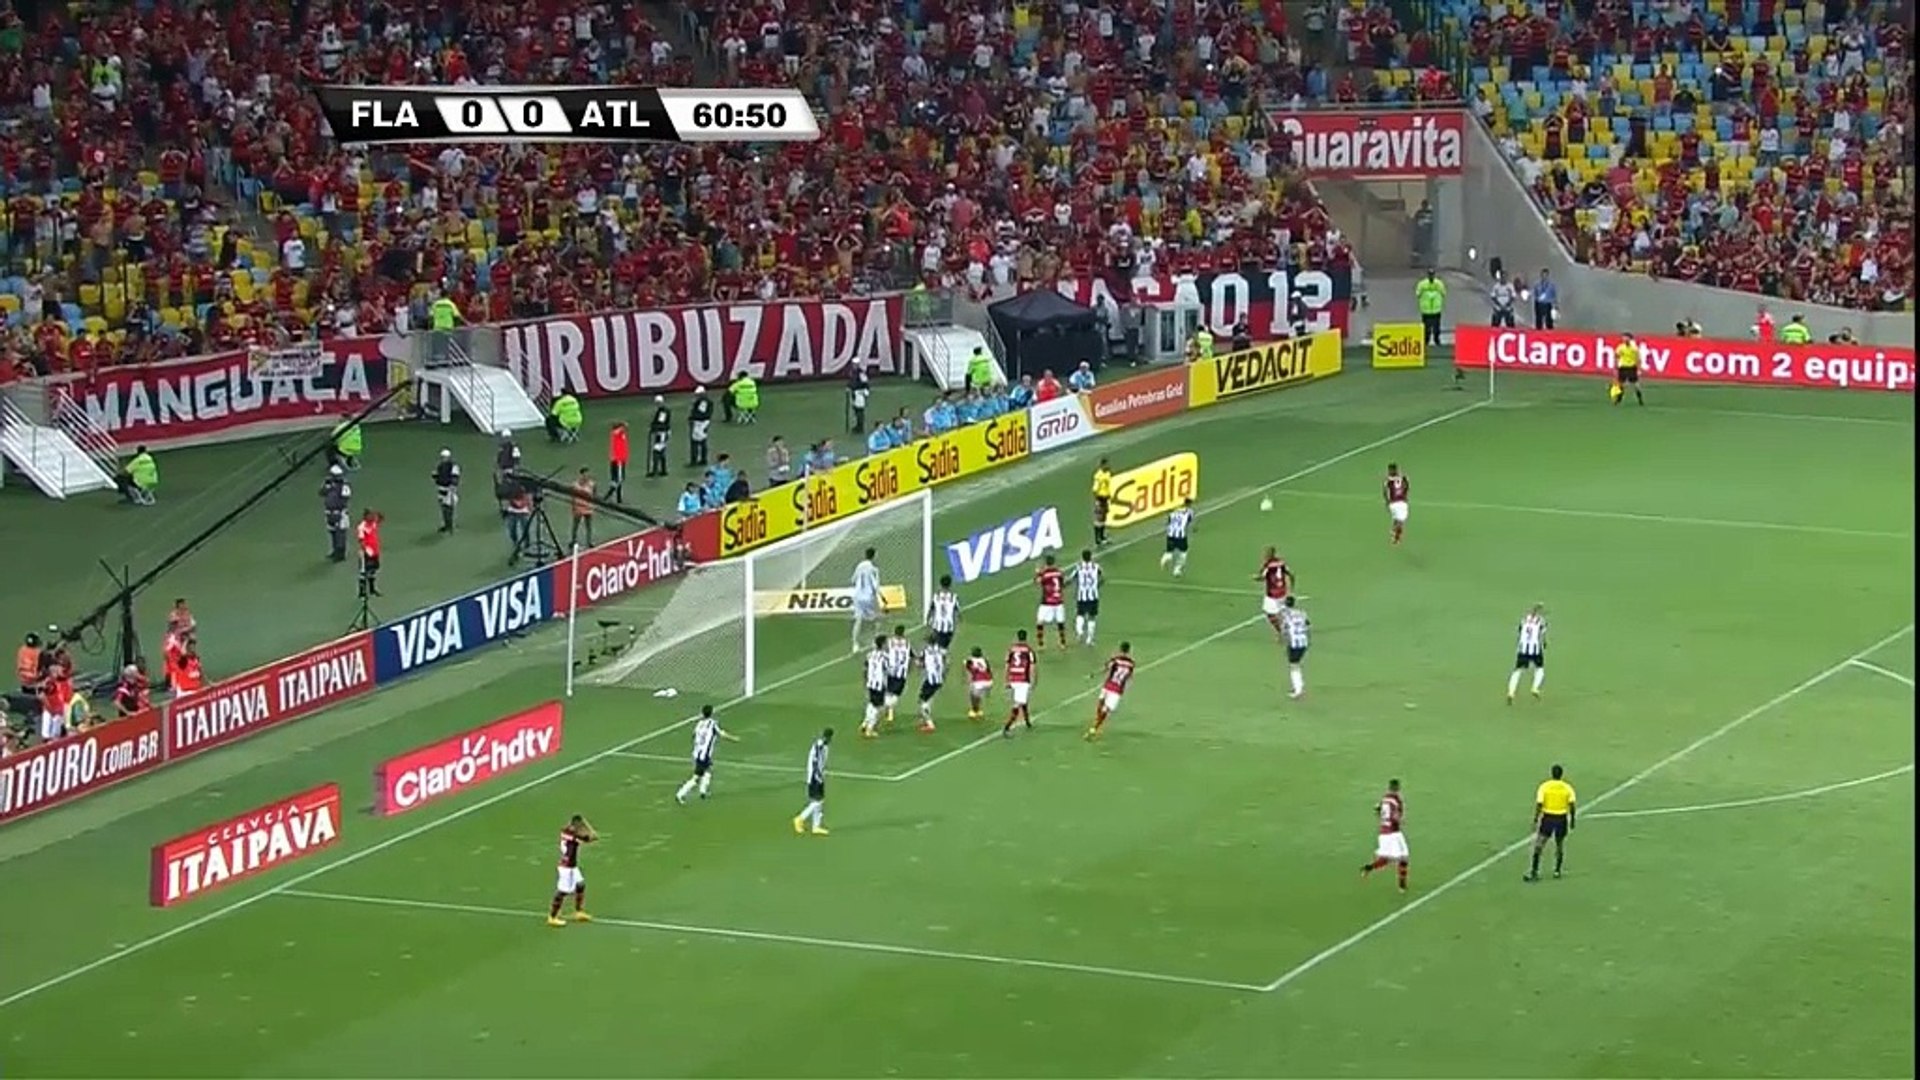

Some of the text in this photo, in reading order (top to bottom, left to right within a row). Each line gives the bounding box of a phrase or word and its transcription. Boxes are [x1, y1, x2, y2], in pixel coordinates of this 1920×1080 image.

[1283, 116, 1461, 169] Guaravita
[1269, 269, 1332, 337] 12
[505, 299, 895, 399] URUBUZADA
[1215, 337, 1314, 393] VEDACIT
[1375, 334, 1422, 358] Sadia
[1496, 332, 1586, 368] Claro
[1596, 336, 1671, 373] htv
[1685, 350, 1761, 377] com
[1771, 351, 1793, 379] 2
[917, 443, 960, 484] Sadia
[985, 420, 1028, 462] Sadia
[793, 478, 838, 526] Sadia
[855, 461, 899, 505] Sadia
[1111, 465, 1193, 521] Sadia
[724, 504, 767, 550] Sadia
[947, 507, 1063, 583] VISA
[475, 575, 542, 639] VISA
[586, 559, 640, 600] Claro
[787, 592, 855, 610] Niko
[390, 604, 463, 670] VISA
[278, 648, 368, 713] ITAIPAVA
[175, 684, 270, 749] ITAIPAVA
[394, 722, 554, 808] Claro hdtv
[167, 804, 336, 901] ITAIPAVA
